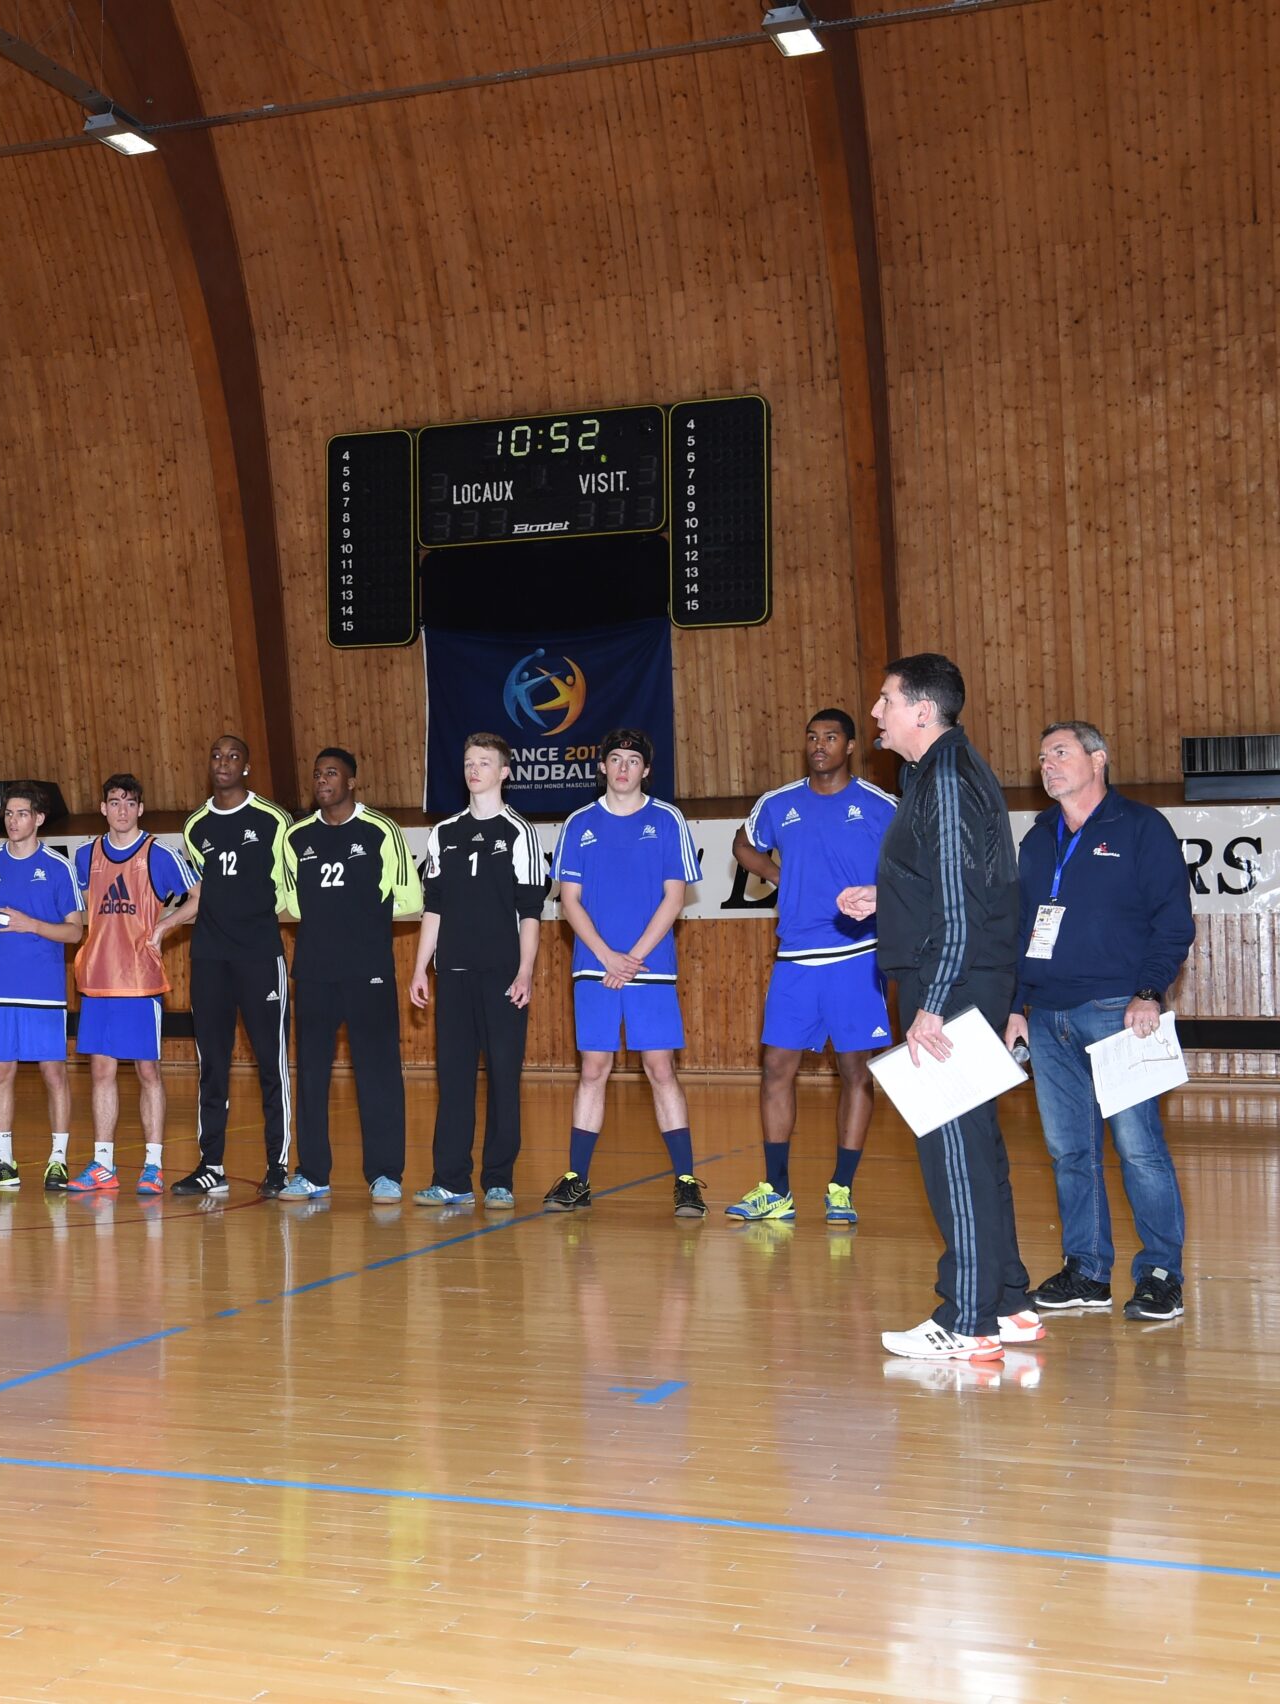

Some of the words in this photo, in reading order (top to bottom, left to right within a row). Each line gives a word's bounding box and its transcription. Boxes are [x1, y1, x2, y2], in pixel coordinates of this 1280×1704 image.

[686, 419, 696, 430] 4
[496, 419, 600, 457] 10:52
[686, 435, 696, 447] 5
[341, 450, 351, 461] 4
[686, 451, 696, 463] 6
[341, 466, 351, 477] 5
[686, 468, 696, 479] 7
[341, 481, 351, 492] 6
[577, 470, 630, 495] VISIT.
[452, 480, 514, 505] LOCAUX
[686, 484, 696, 496] 8
[341, 497, 351, 508] 7
[686, 501, 696, 513] 9
[341, 512, 351, 523] 8
[684, 517, 699, 529] 10
[341, 528, 351, 539] 9
[685, 534, 699, 545] 11
[340, 543, 354, 554] 10
[684, 550, 699, 562] 12
[340, 559, 354, 570] 11
[684, 566, 699, 578] 13
[340, 574, 354, 585] 12
[684, 583, 699, 595] 14
[340, 590, 354, 601] 13
[340, 605, 354, 616] 14
[684, 599, 700, 611] 15
[340, 620, 355, 632] 15
[510, 747, 559, 762] ANCE
[508, 762, 600, 781] NDBAL
[218, 851, 238, 876] 12
[468, 851, 479, 877] 1
[320, 862, 345, 888] 22
[98, 900, 137, 915] adidas
